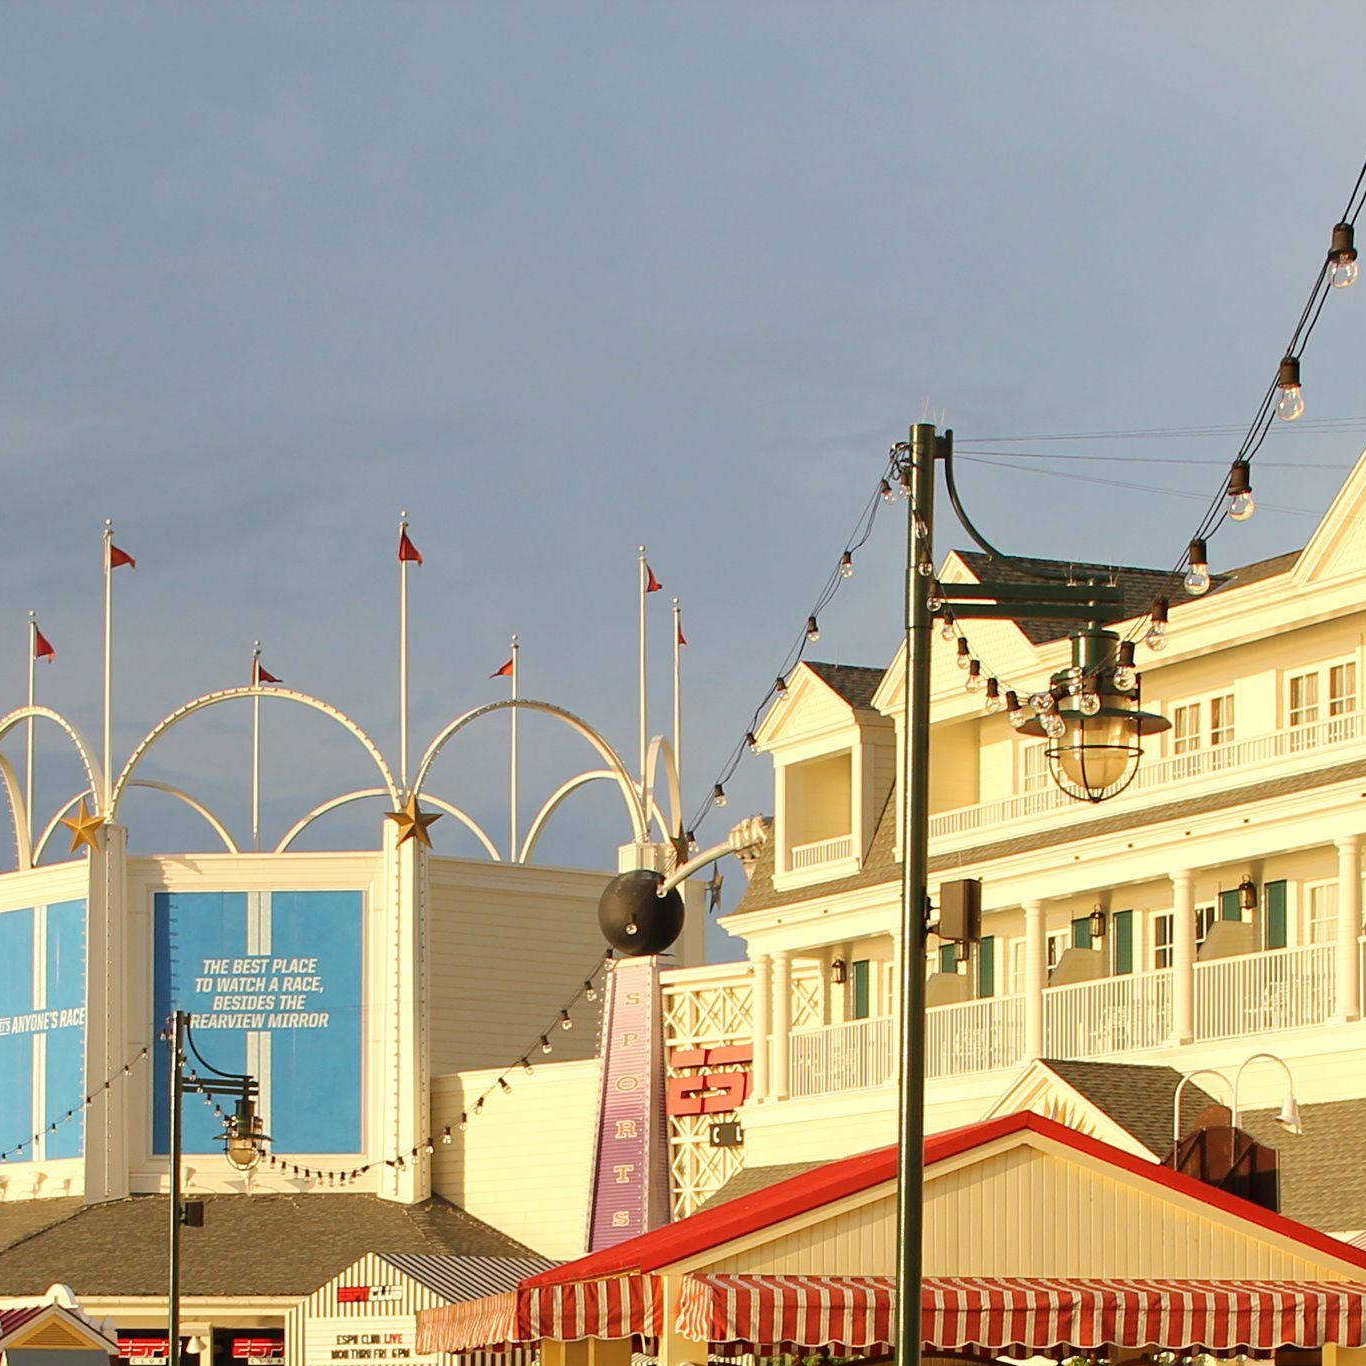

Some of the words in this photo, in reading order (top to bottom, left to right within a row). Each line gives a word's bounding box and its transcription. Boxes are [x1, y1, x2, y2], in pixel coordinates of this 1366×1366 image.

[203, 959, 230, 974] THE
[232, 959, 270, 974] BEST
[271, 958, 318, 974] PLACE
[195, 977, 213, 992] TO
[216, 977, 266, 992] WATCH
[268, 977, 279, 992] A
[282, 976, 324, 994] RACE,
[212, 996, 276, 1011] BESIDES
[279, 995, 307, 1010] THE
[11, 1011, 59, 1034] ANYONE'S
[59, 1007, 85, 1027] RACE
[190, 1013, 266, 1029] REARVIEW
[267, 1013, 330, 1029] MIRROR
[611, 992, 640, 1227] SPORTS
[337, 1334, 359, 1345] ESPN
[384, 1333, 404, 1344] LIVE
